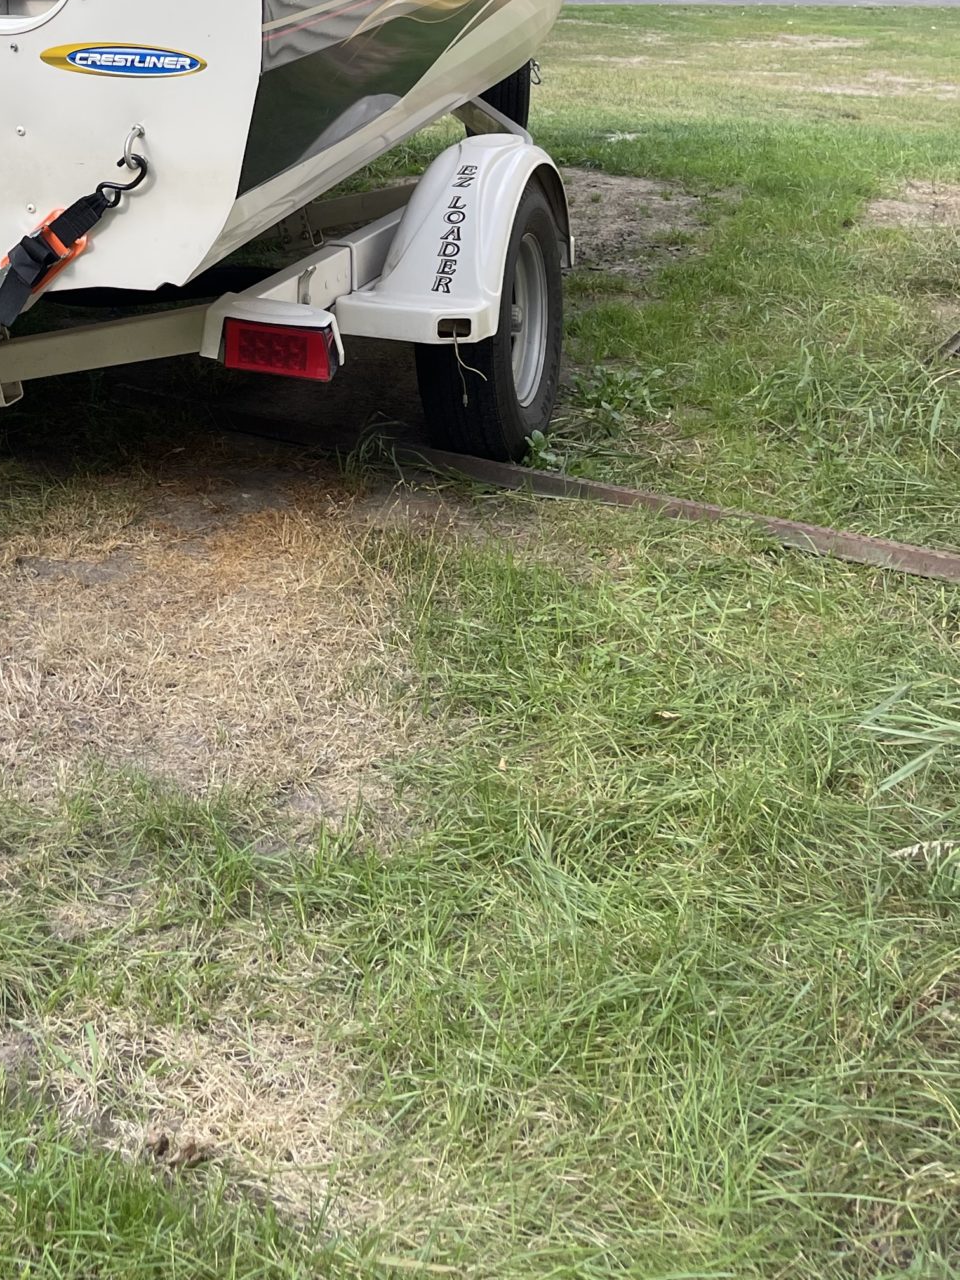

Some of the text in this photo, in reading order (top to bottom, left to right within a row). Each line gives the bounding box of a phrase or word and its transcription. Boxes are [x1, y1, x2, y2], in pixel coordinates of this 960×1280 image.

[75, 52, 191, 70] CRESTLINER
[431, 165, 478, 294] EZ LOADER
